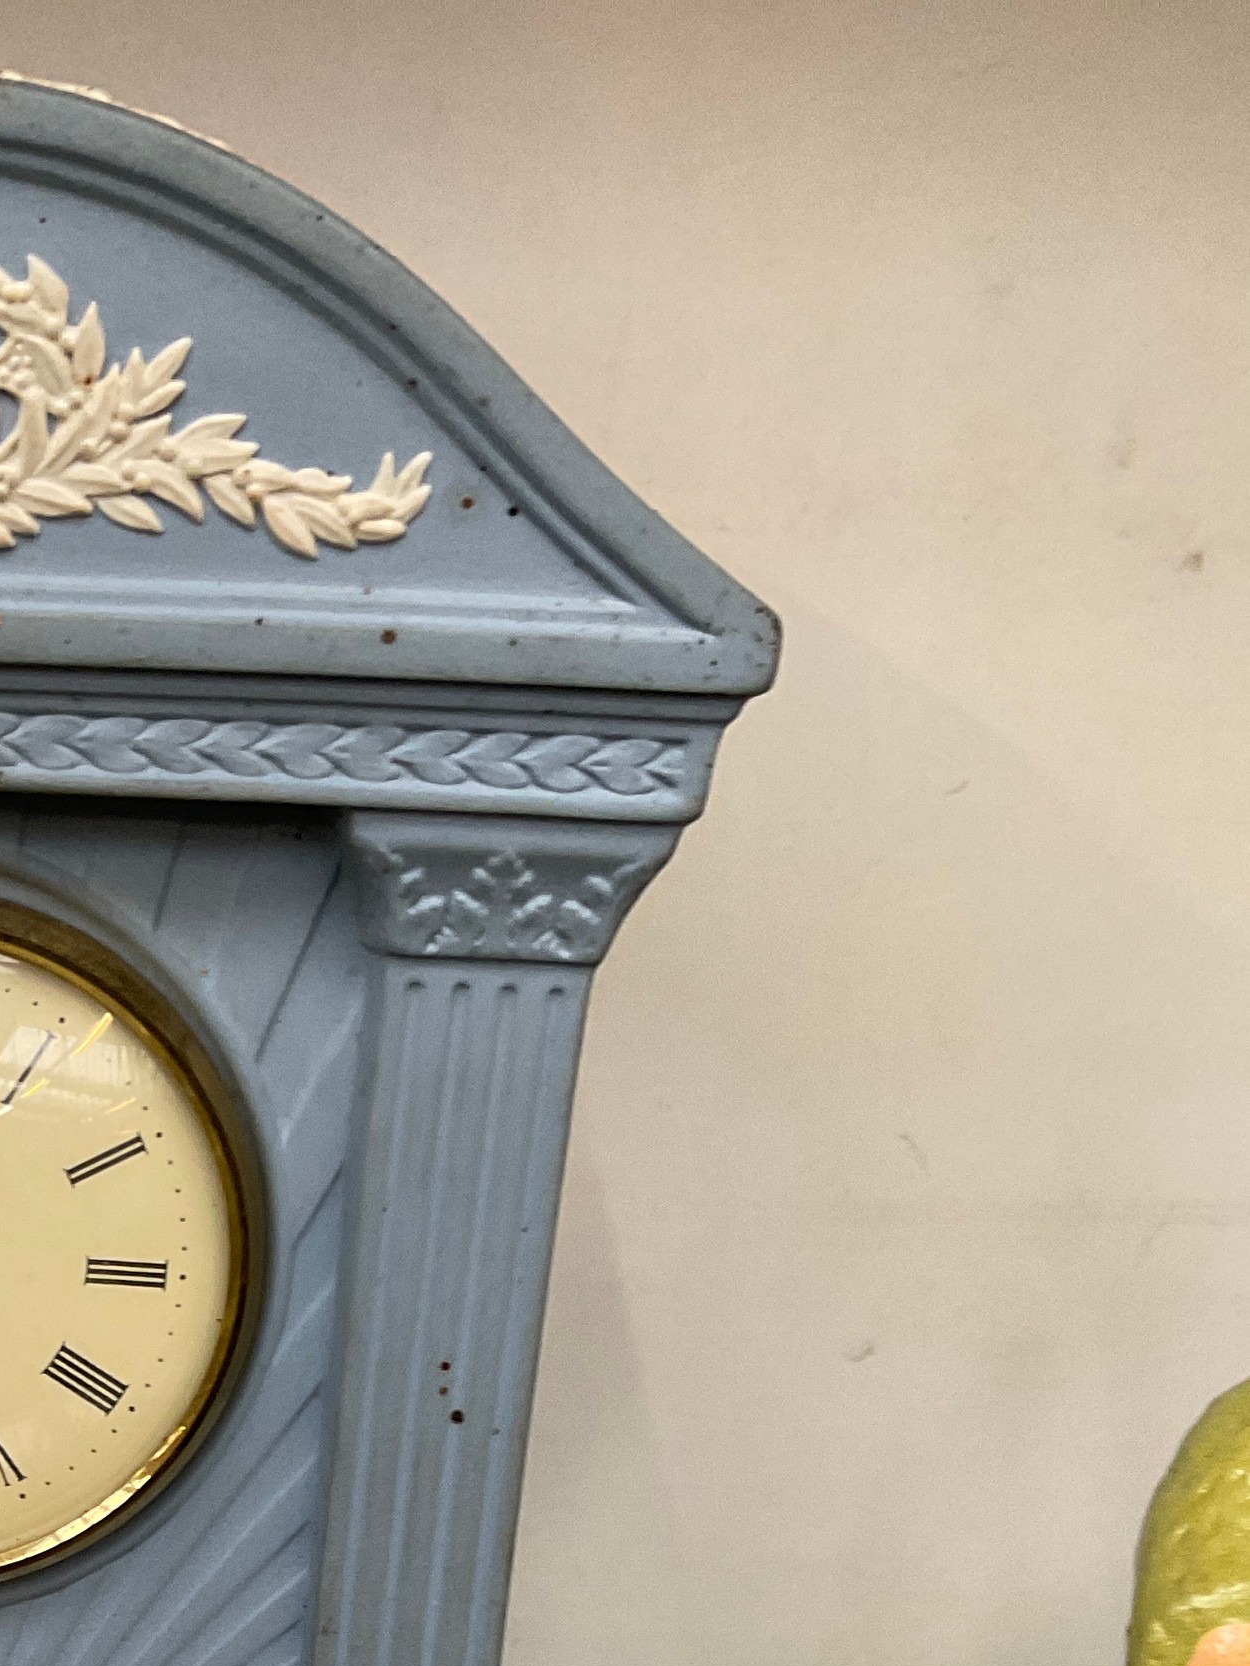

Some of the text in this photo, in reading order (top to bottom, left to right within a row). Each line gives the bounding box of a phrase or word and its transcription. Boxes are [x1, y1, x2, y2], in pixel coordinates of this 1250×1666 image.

[0, 1030, 57, 1105] I
[62, 1132, 149, 1188] II
[84, 1256, 168, 1290] III
[40, 1341, 130, 1416] IIII
